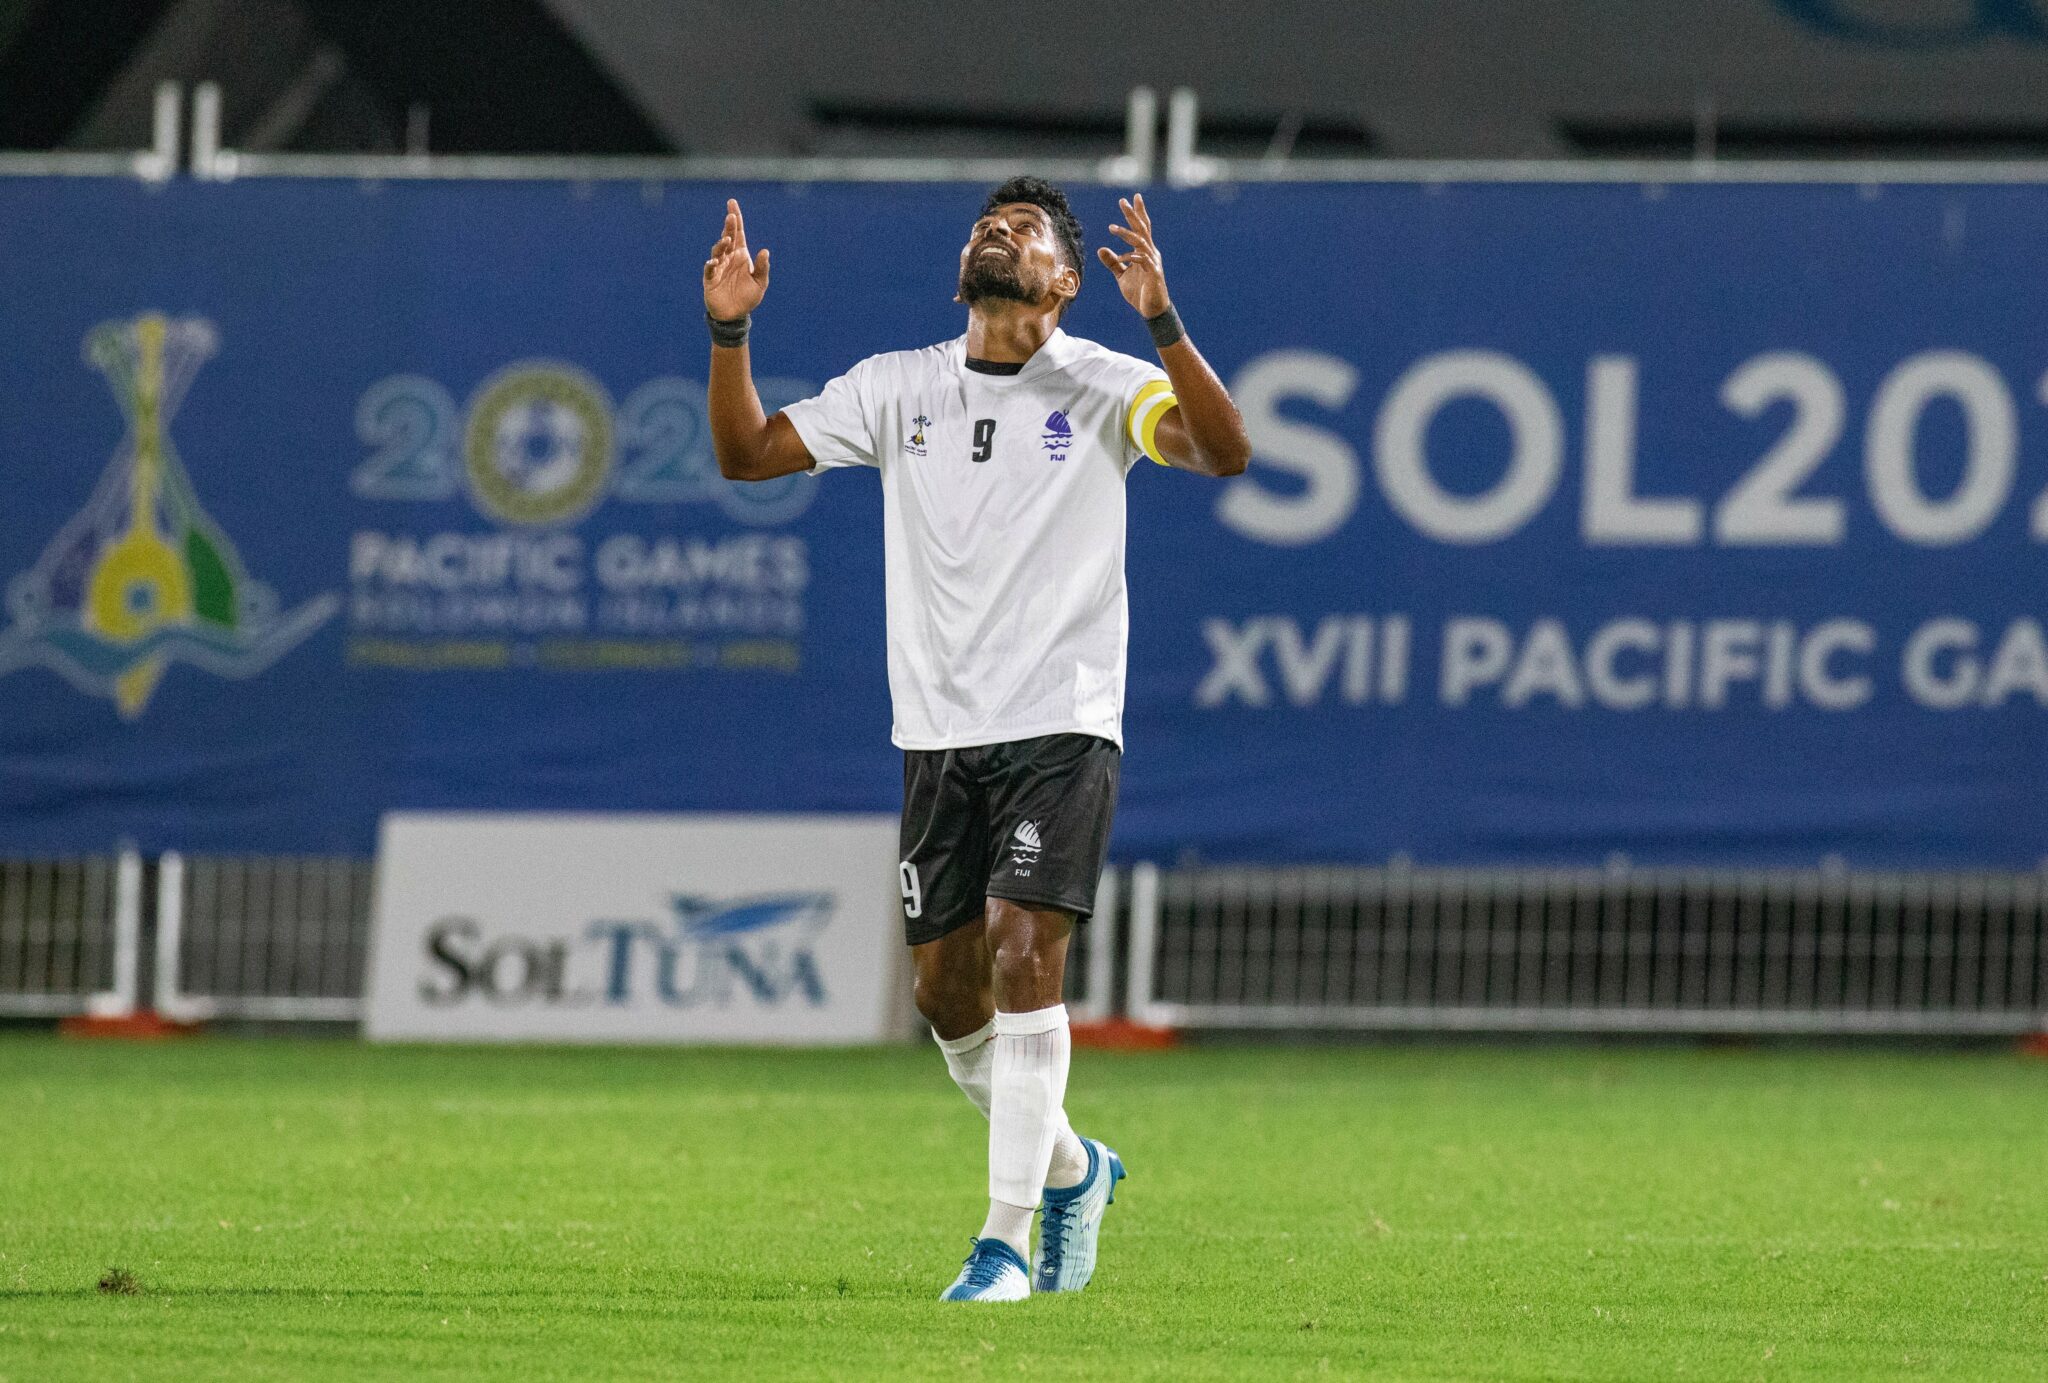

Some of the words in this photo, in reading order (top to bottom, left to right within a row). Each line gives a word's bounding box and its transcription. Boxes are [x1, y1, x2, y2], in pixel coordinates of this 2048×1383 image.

[972, 419, 996, 463] 9
[1050, 454, 1066, 462] FIJI
[1216, 349, 2048, 546] SOL20
[348, 532, 584, 590] PACIFIC
[598, 534, 807, 589] GAMES
[1198, 617, 1411, 707] XVII
[1440, 617, 1876, 709] PACIFIC
[900, 861, 922, 918] 9
[1015, 869, 1030, 877] FIJI
